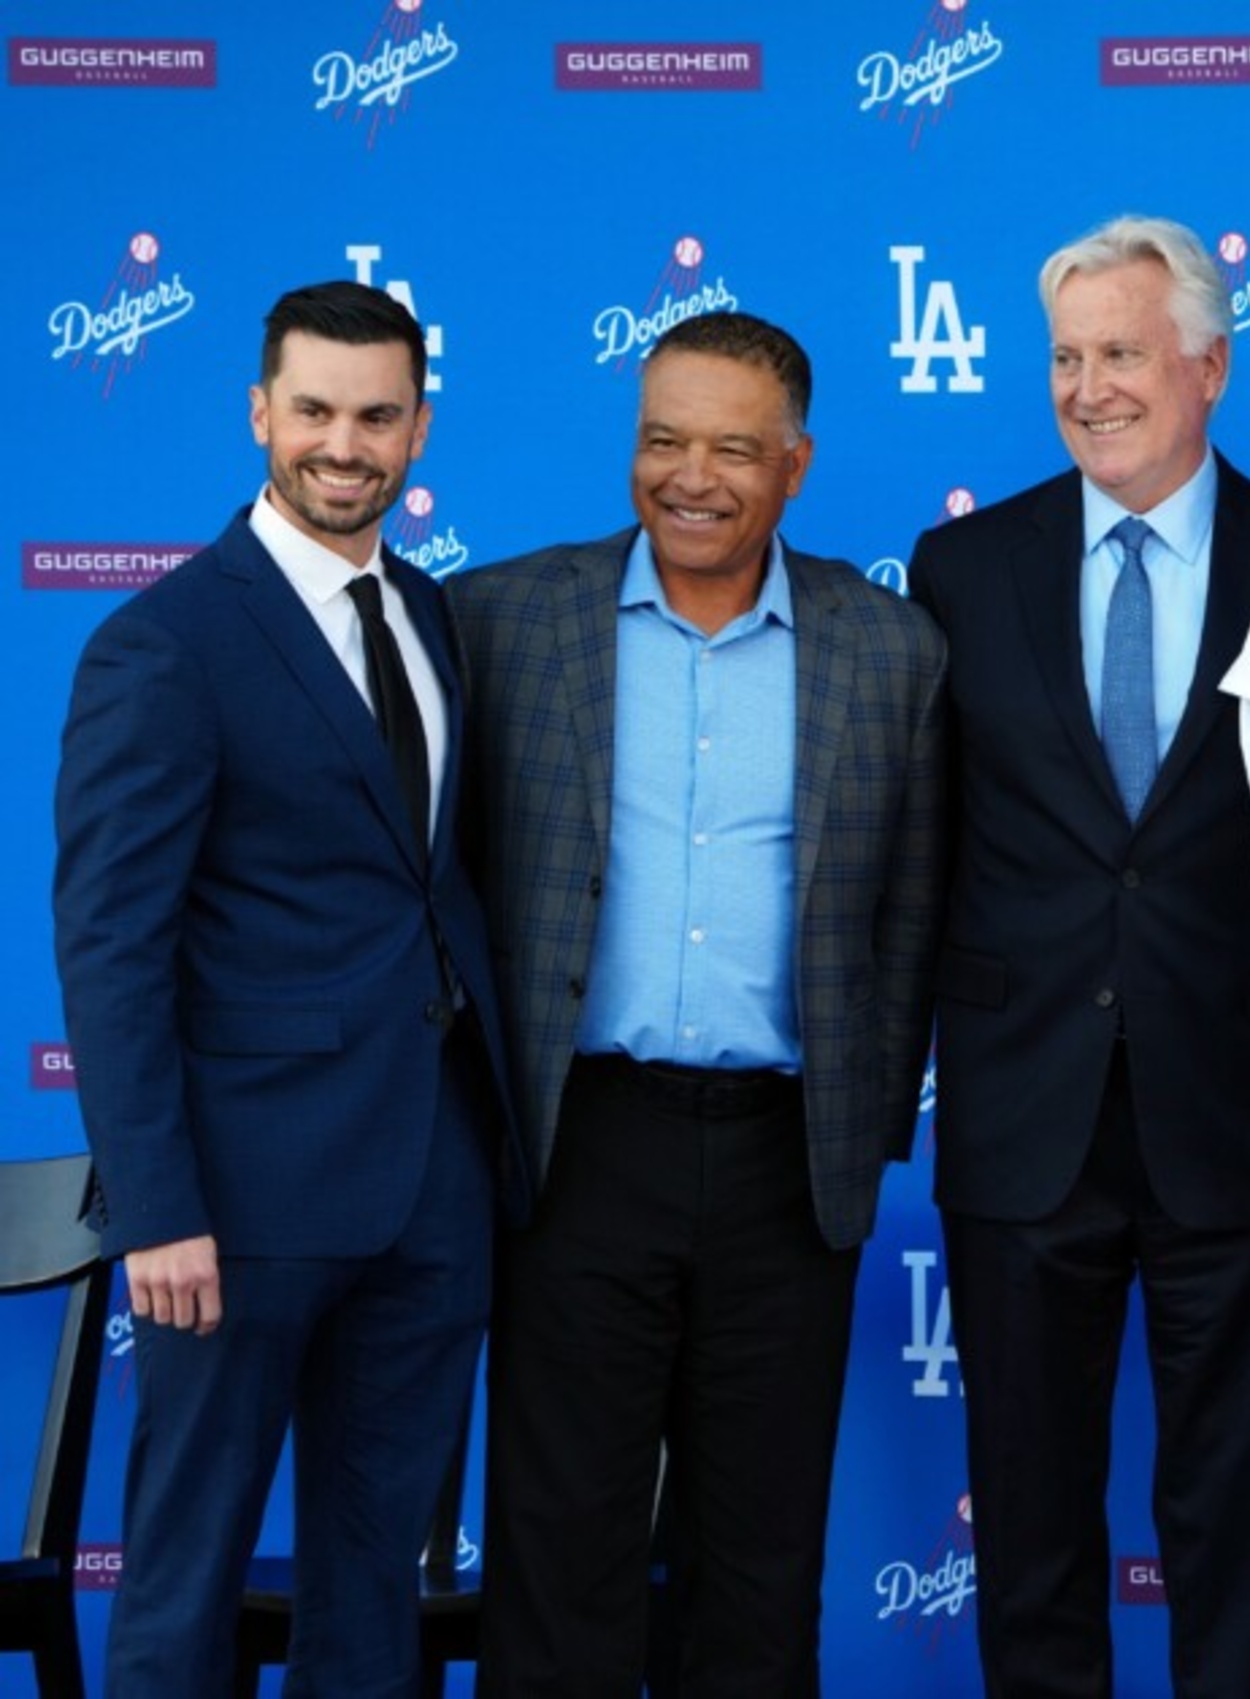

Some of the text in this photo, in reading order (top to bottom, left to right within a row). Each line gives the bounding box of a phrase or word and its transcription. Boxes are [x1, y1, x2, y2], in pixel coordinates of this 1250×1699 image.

[20, 47, 204, 68] GUGGENHEIM
[313, 22, 458, 110] Dodgers
[567, 52, 750, 72] GUGGENHEIM
[858, 21, 1002, 111] Dodgers
[1167, 69, 1240, 80] BASEBALL
[621, 75, 692, 85] BASEBALL
[48, 273, 194, 359] Dodgers
[890, 246, 985, 393] LA
[34, 552, 194, 572] GUGGENHE
[875, 1551, 976, 1619] Dodg
